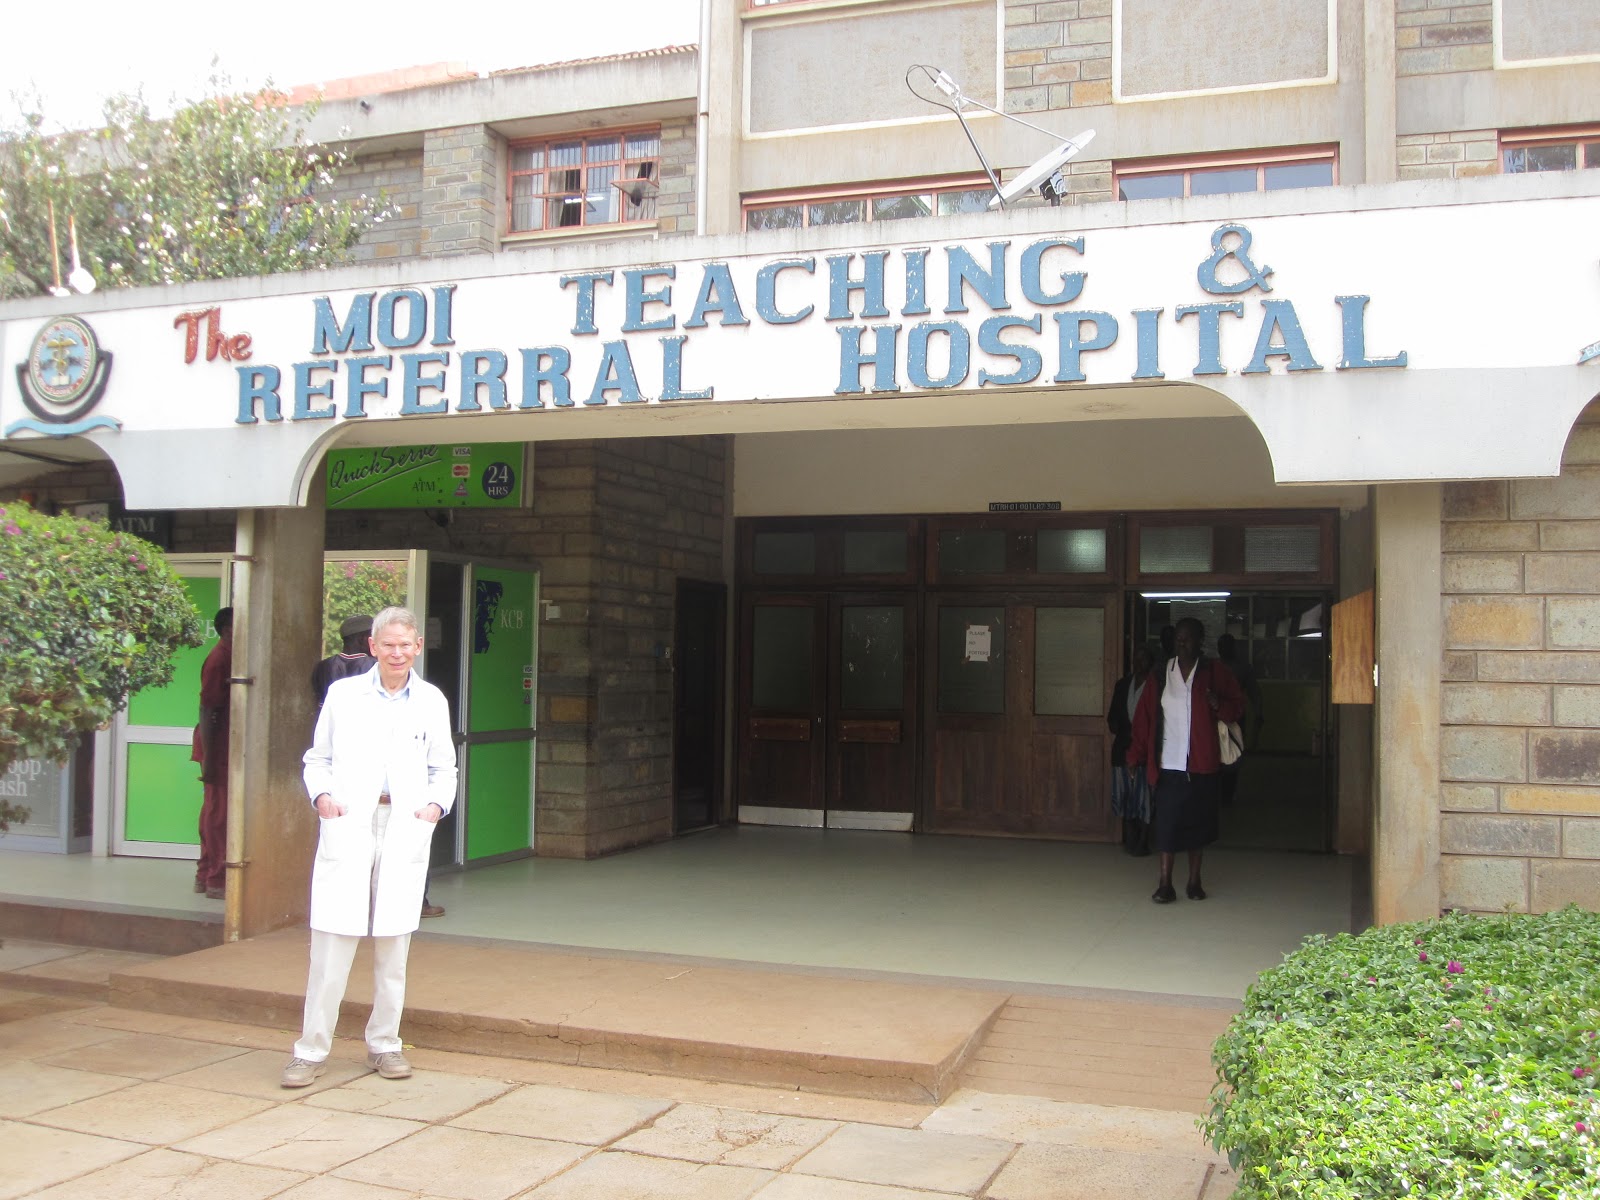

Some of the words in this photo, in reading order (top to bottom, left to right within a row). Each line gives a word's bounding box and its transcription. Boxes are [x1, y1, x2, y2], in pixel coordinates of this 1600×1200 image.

[174, 306, 252, 364] The
[311, 283, 458, 355] MOI
[560, 236, 1088, 336] TEACHING
[1197, 223, 1274, 295] &
[235, 334, 714, 424] REFERRAL
[834, 294, 1408, 394] HOSPITAL
[455, 447, 471, 456] VISA
[487, 465, 509, 484] 24
[412, 480, 436, 493] ATM
[488, 486, 509, 496] HRS
[114, 516, 156, 533] ATM
[501, 609, 523, 629] KCB
